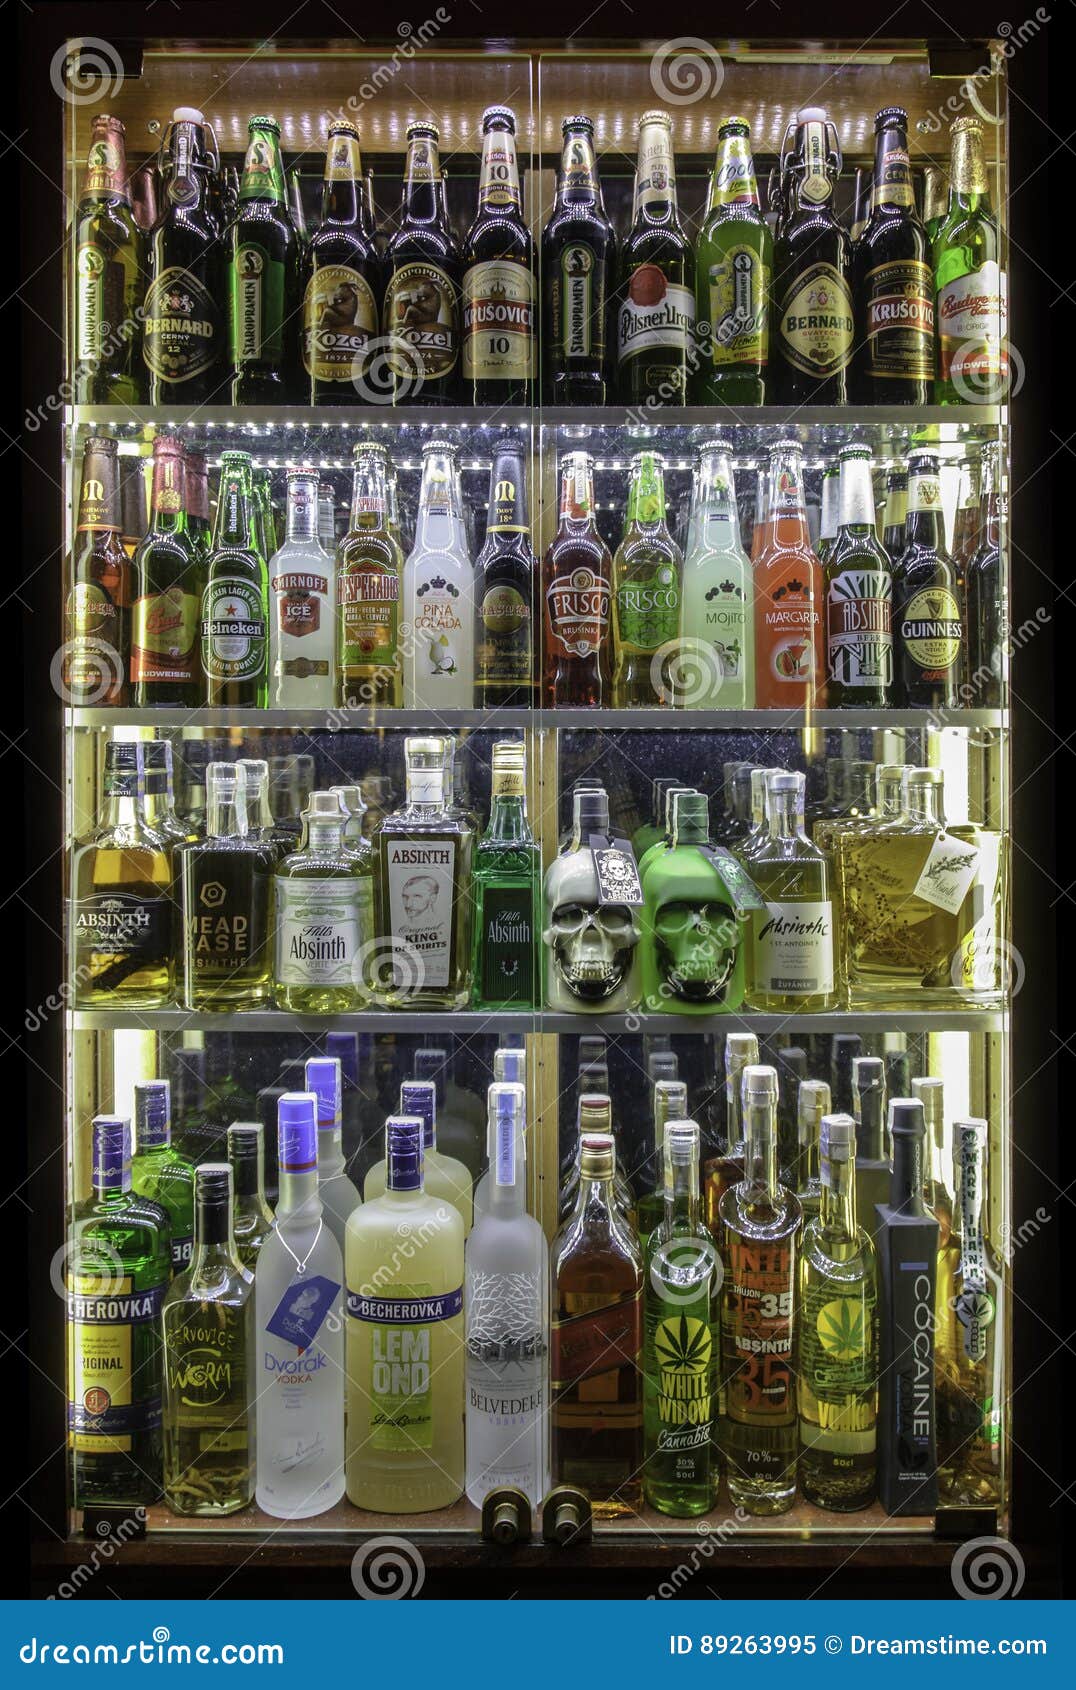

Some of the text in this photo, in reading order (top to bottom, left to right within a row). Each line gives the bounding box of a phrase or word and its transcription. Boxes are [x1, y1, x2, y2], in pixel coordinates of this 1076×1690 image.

[177, 137, 187, 176] BERNARD
[490, 165, 508, 180] 10
[83, 282, 96, 356] STAROPRAMEN
[242, 281, 256, 355] STAROPRAMEN
[571, 280, 585, 353] STAROPRAMEN
[621, 306, 666, 346] Pilsner
[787, 315, 853, 332] BERNARD
[145, 318, 213, 338] BERNARD
[389, 327, 452, 349] Kozel
[306, 329, 369, 353] Kozel
[489, 337, 510, 354] 10
[229, 494, 237, 532] Heineken
[273, 576, 327, 591] SMIRNOFF
[286, 606, 311, 616] ICE
[554, 593, 608, 617] FRISCO
[618, 590, 678, 612] FRISCO
[203, 621, 261, 635] Heineken
[415, 617, 461, 630] COLADA
[901, 621, 962, 638] GUINNESS
[392, 851, 451, 864] ABSINTH
[76, 913, 150, 926] ABSINTH
[759, 916, 829, 941] Absinthe
[405, 932, 438, 943] KING
[488, 921, 531, 943] Absinth
[290, 936, 346, 960] Absinth
[361, 1301, 443, 1319] BECHEROVKA
[760, 1291, 792, 1318] 35
[373, 1329, 430, 1362] LEM
[736, 1335, 791, 1354] ABSINTH
[913, 1274, 930, 1436] COCAINE
[277, 1375, 312, 1384] VODKA
[373, 1362, 430, 1395] OND
[661, 1371, 708, 1399] WHITE
[471, 1389, 544, 1415] BELVEDERE
[658, 1396, 711, 1424] WIDOW
[657, 1424, 712, 1449] Cannabis
[746, 1450, 771, 1462] 70%
